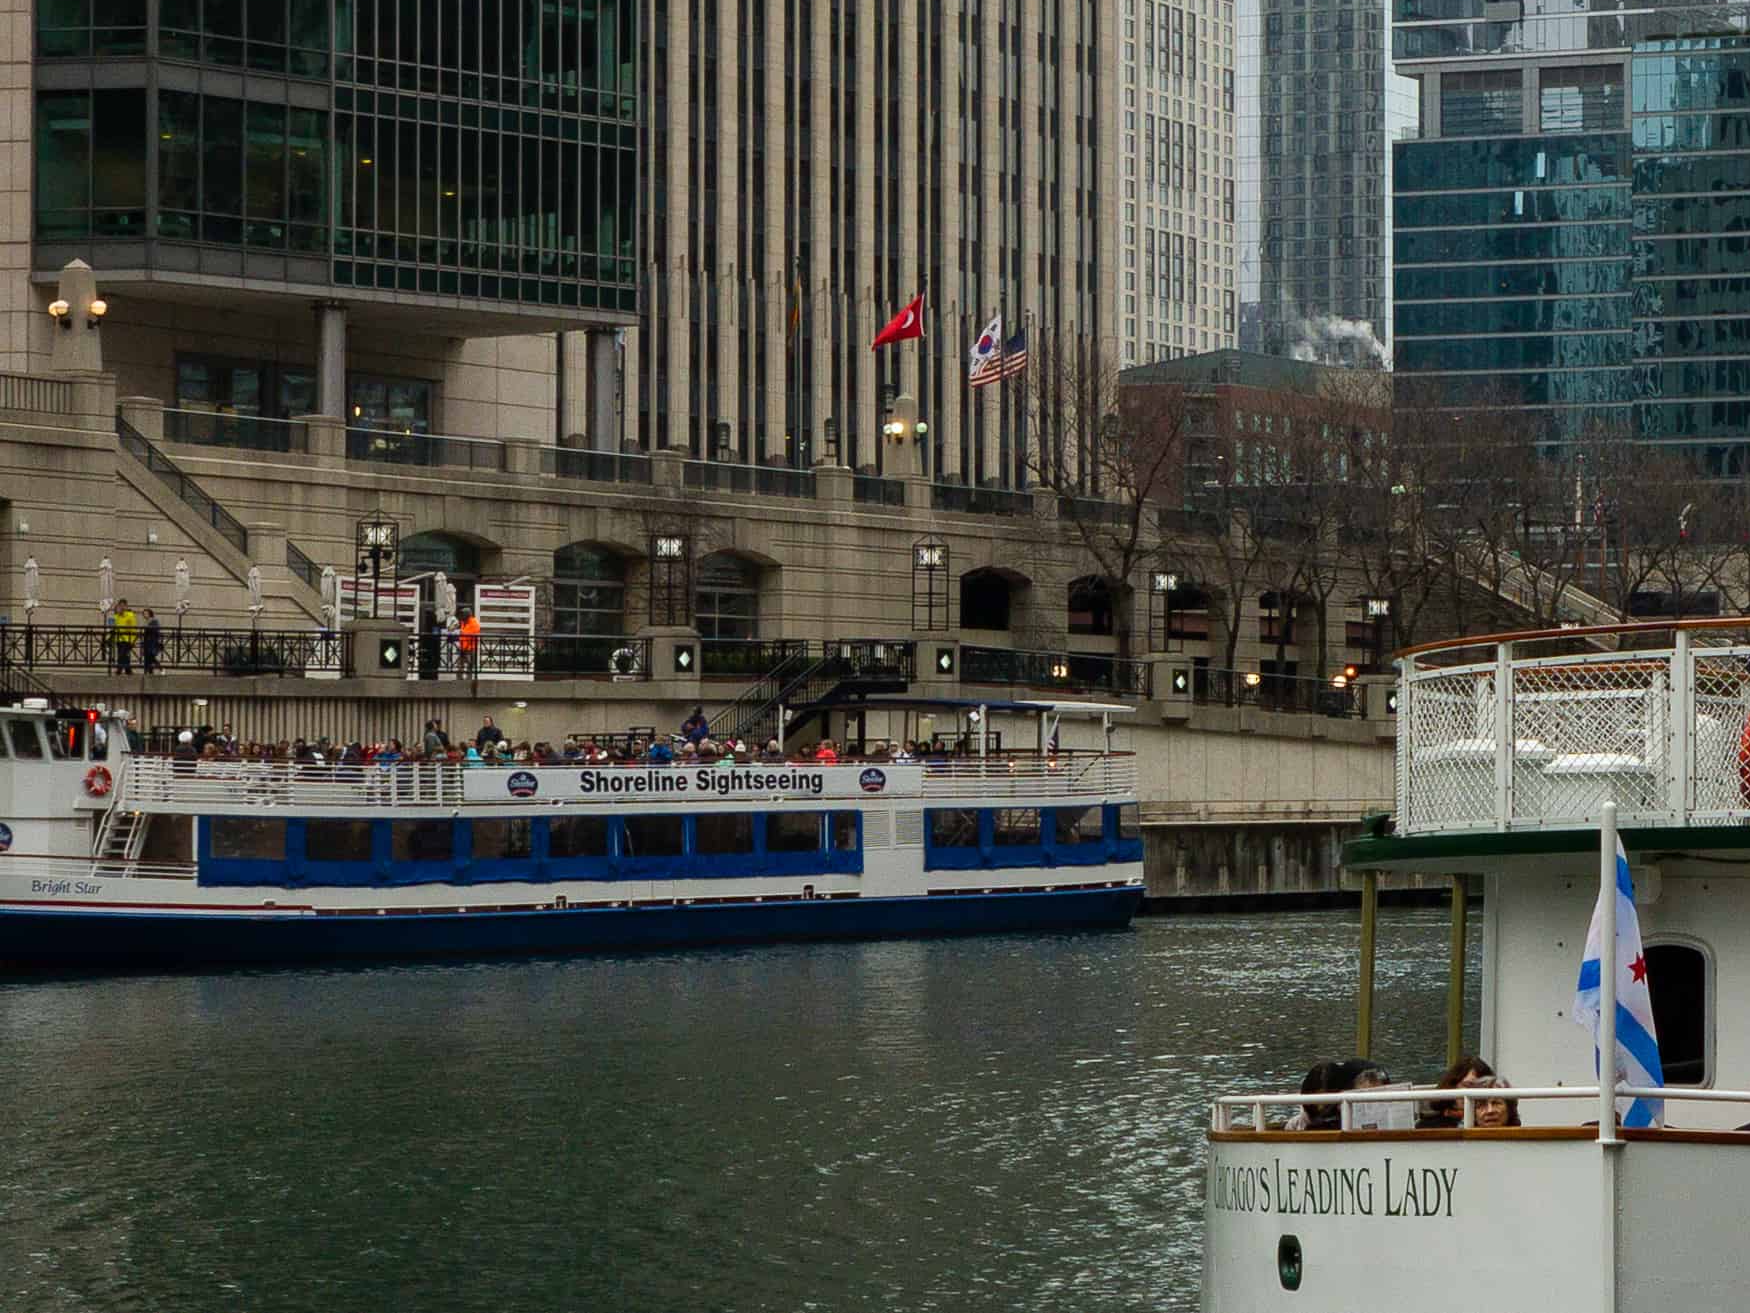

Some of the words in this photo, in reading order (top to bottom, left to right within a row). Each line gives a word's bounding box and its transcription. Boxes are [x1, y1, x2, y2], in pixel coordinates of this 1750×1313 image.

[580, 770, 688, 792] Shoreline
[696, 769, 823, 795] Sightseeing
[32, 879, 71, 897] Bright
[74, 881, 102, 894] Star
